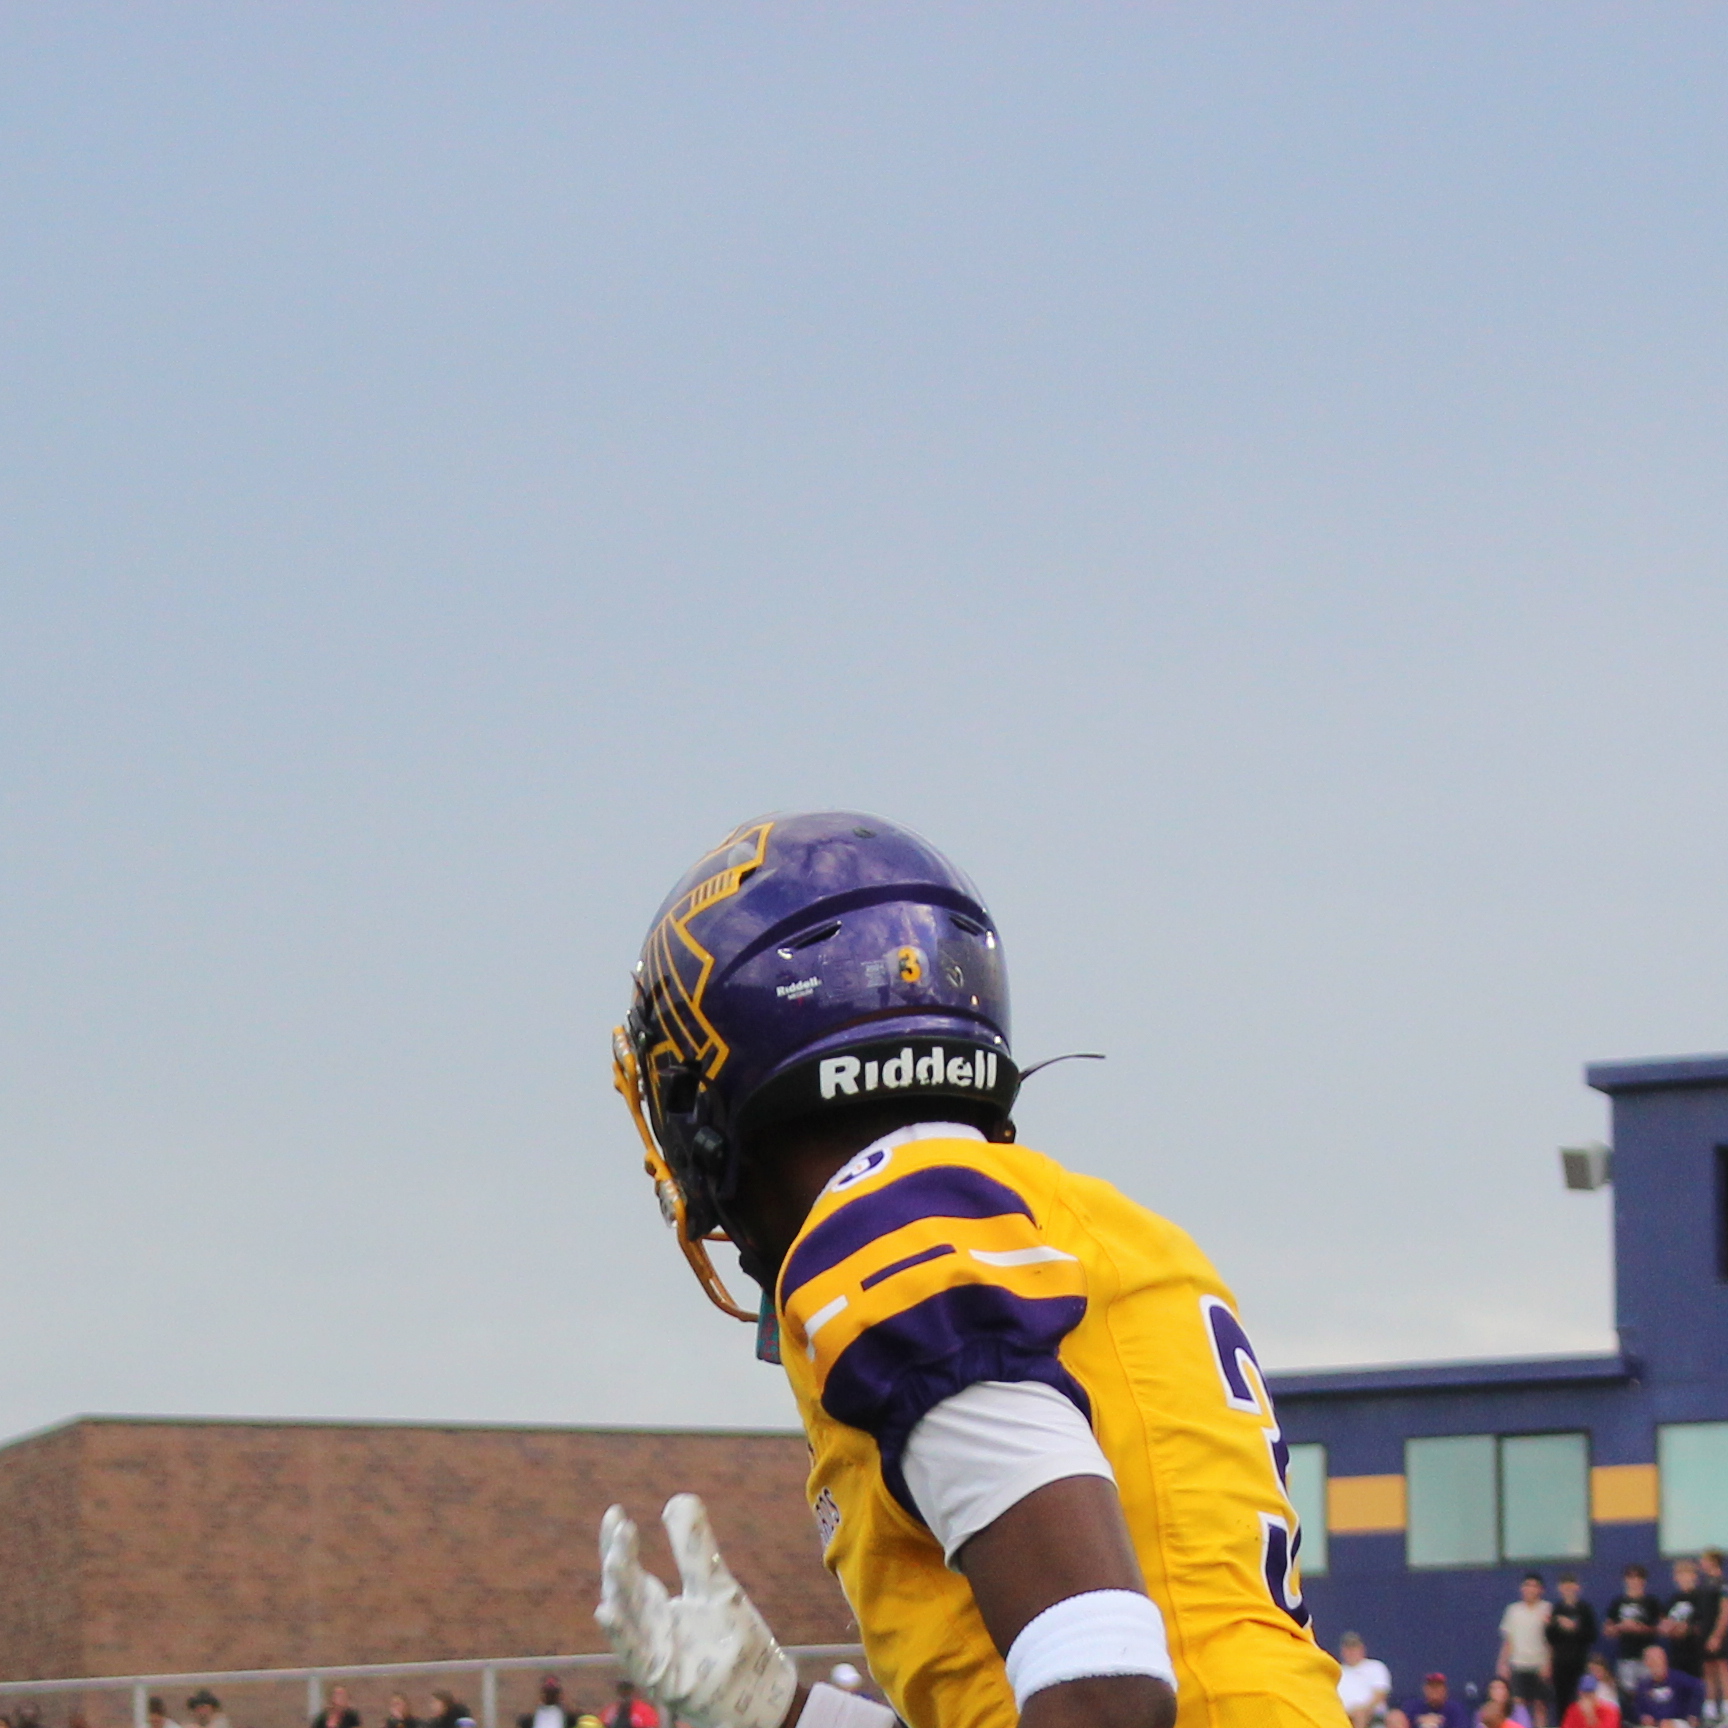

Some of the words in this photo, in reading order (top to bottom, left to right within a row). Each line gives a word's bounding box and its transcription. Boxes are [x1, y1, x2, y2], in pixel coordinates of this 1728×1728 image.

[896, 946, 922, 983] 3
[775, 976, 818, 997] Riddell
[819, 1046, 997, 1100] Riddell
